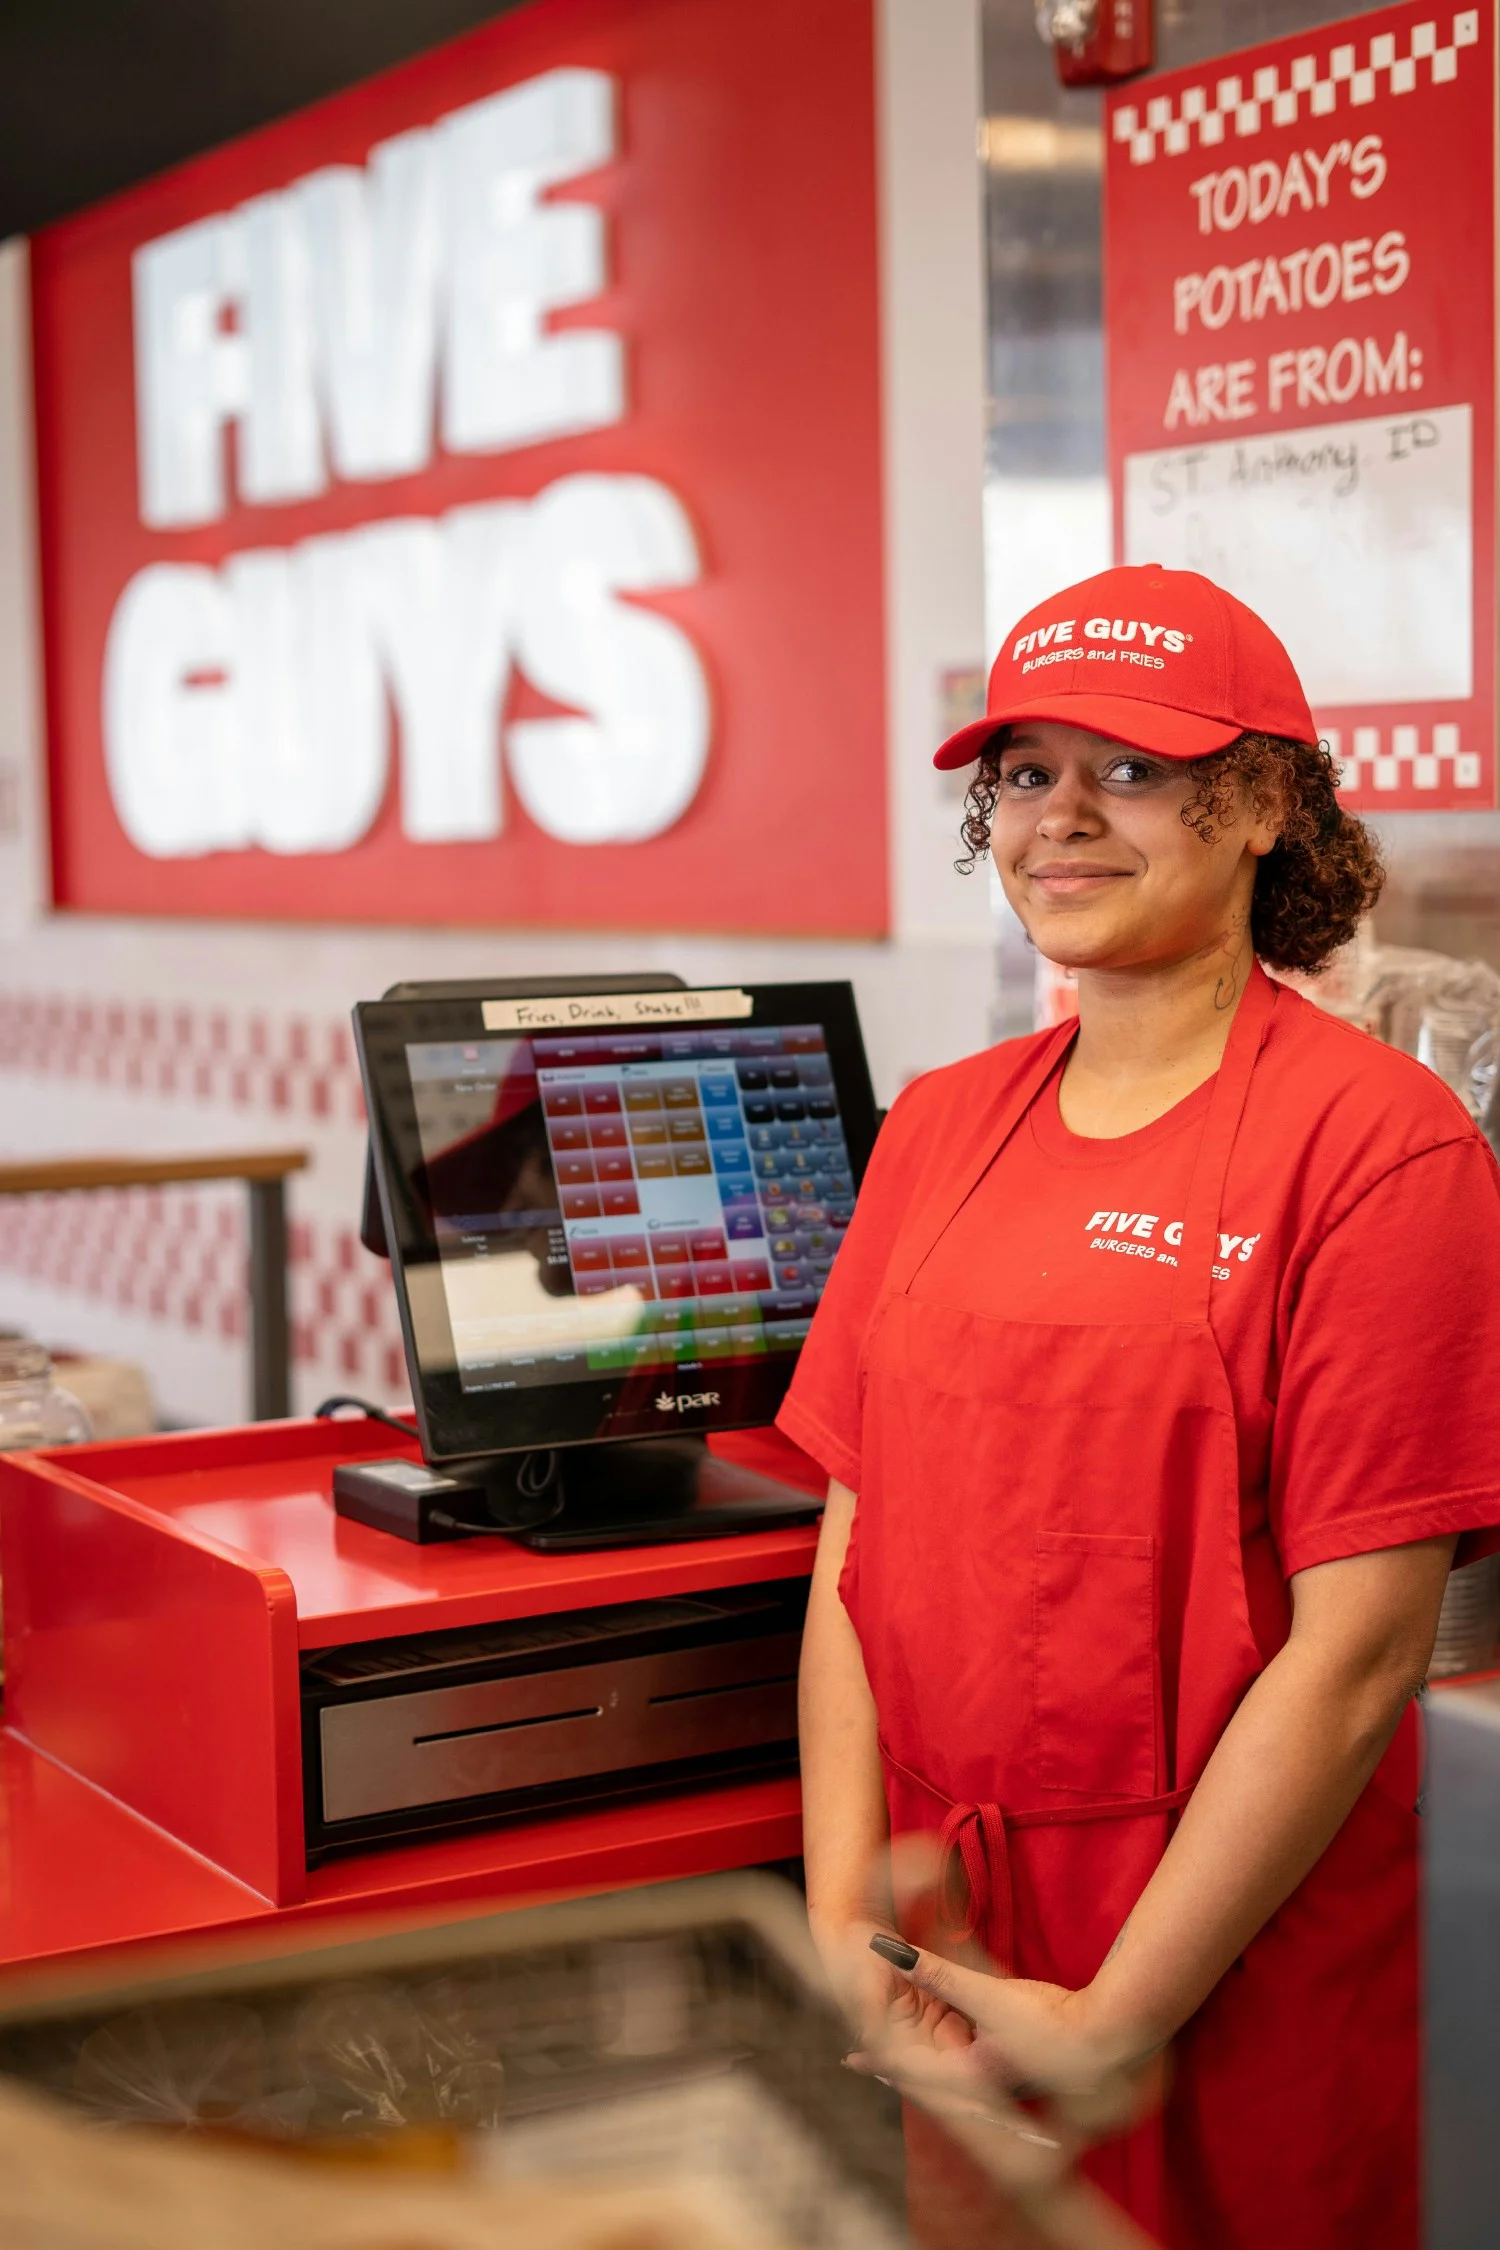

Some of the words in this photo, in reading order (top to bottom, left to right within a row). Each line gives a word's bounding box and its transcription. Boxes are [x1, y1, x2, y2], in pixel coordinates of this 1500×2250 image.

[1189, 134, 1387, 235] TODAY'S
[133, 64, 626, 531] FIVE
[1173, 230, 1411, 335] POTATOES
[1164, 359, 1257, 431] ARE
[1268, 330, 1423, 412] FROM:
[101, 469, 713, 859] GUYS
[1012, 619, 1077, 661] FIVE
[1021, 647, 1084, 674] BURGERS
[1087, 648, 1116, 661] and
[1120, 651, 1165, 669] FRIES
[1085, 1211, 1160, 1239] FIVE
[1163, 1221, 1261, 1262] GYS
[1089, 1237, 1155, 1259] BURGERS
